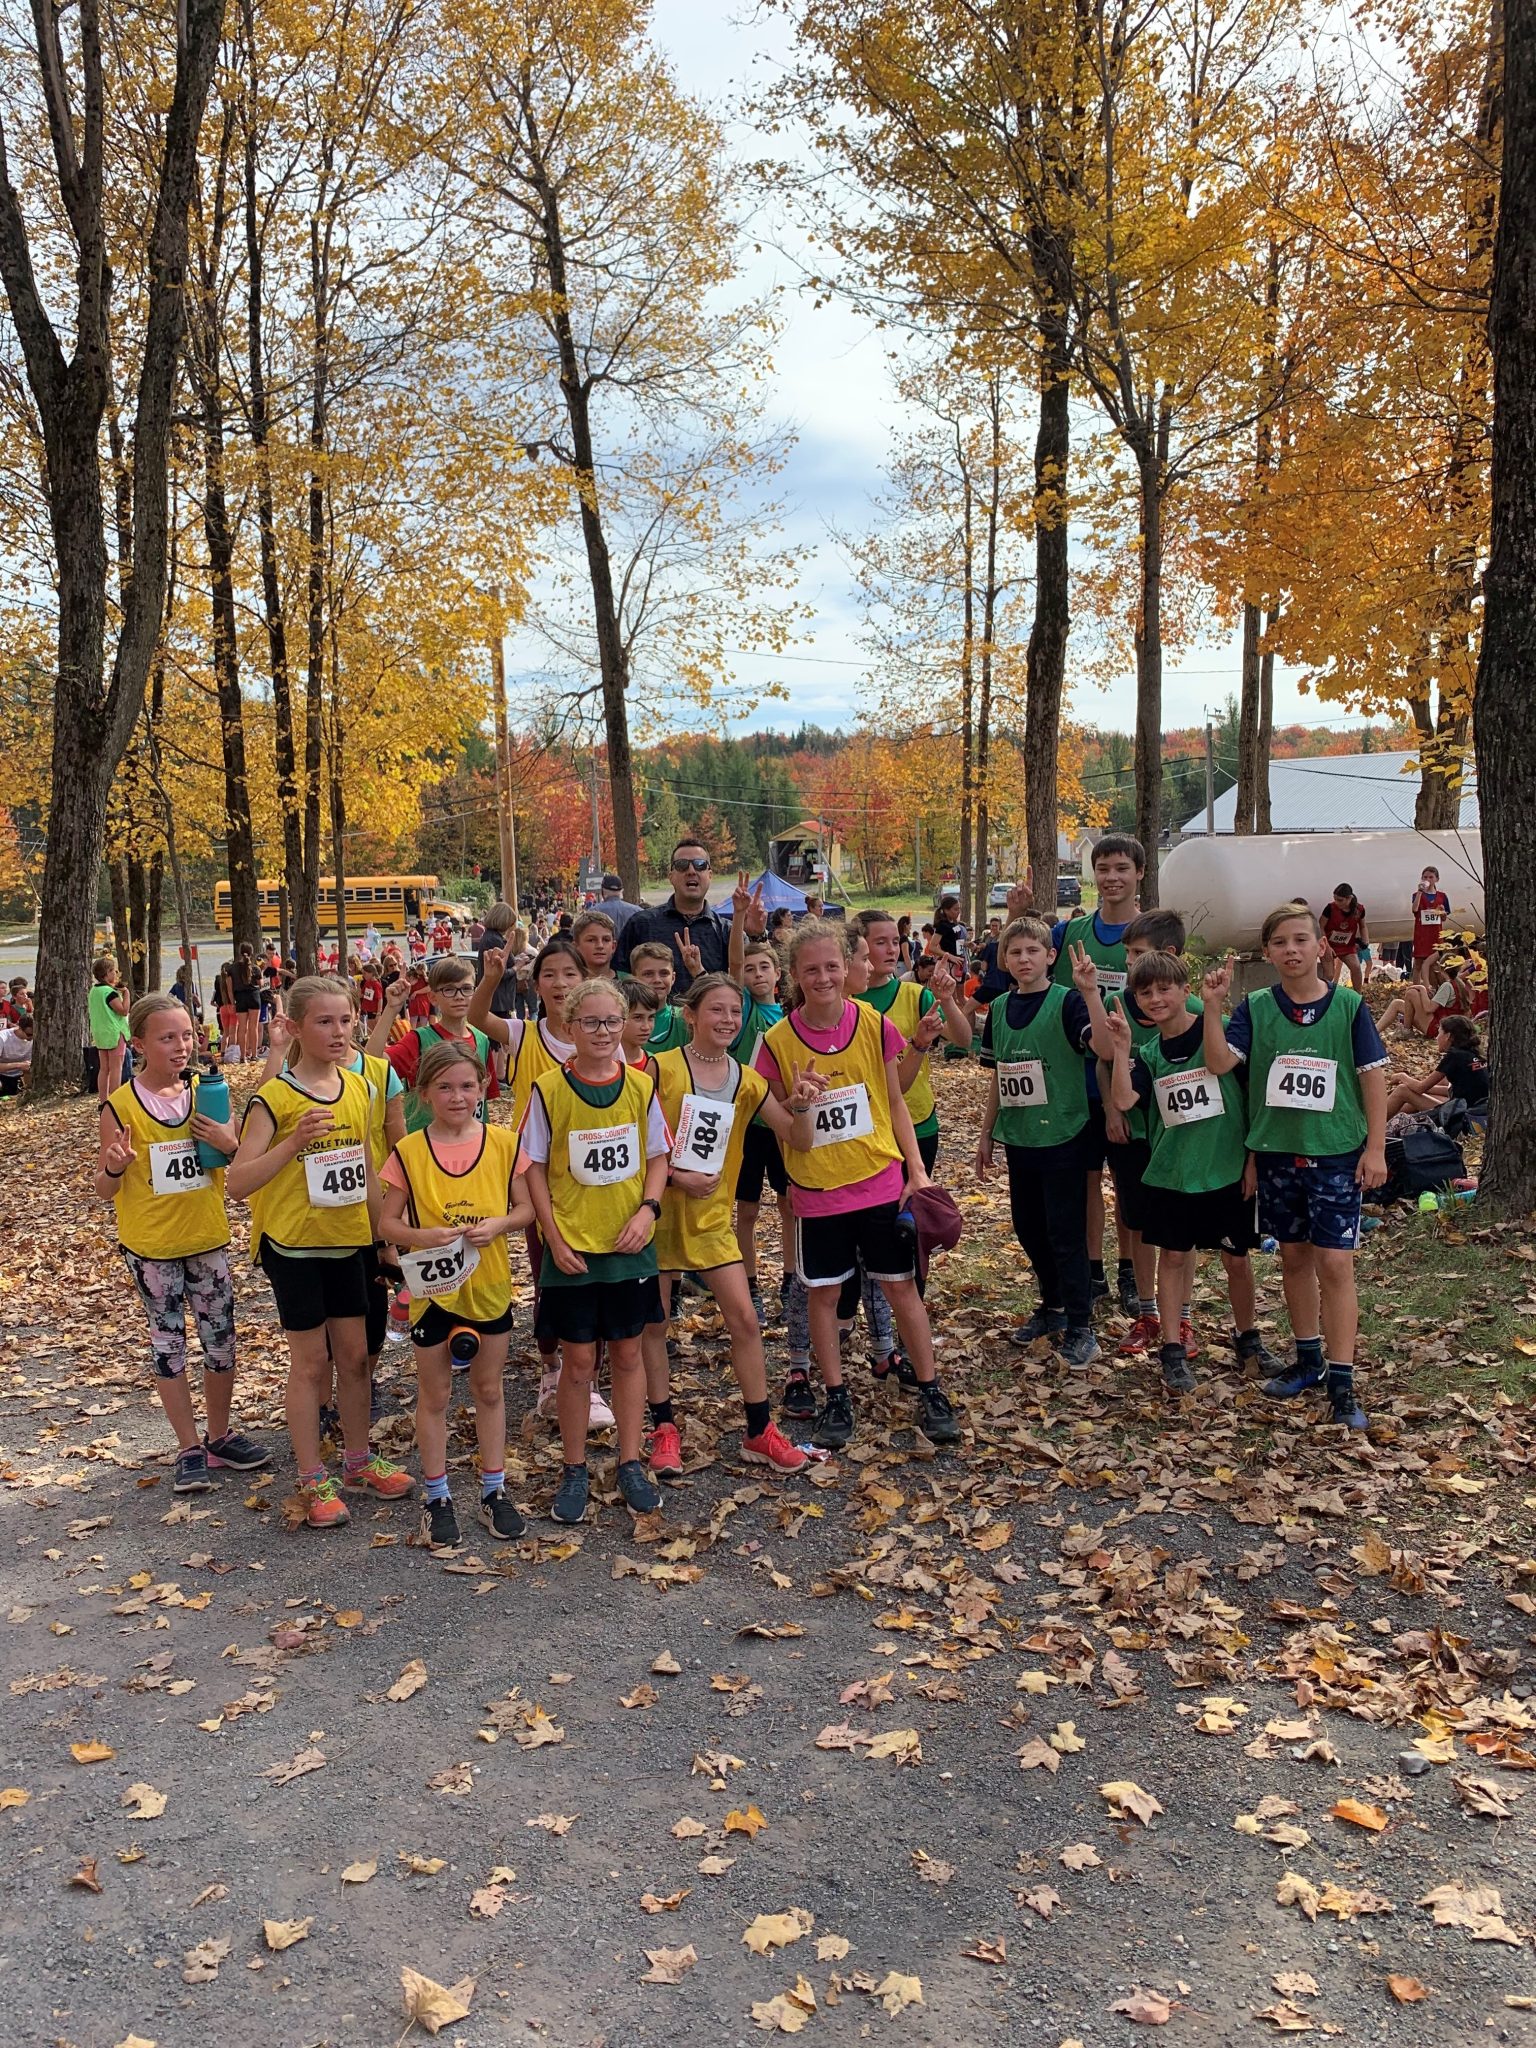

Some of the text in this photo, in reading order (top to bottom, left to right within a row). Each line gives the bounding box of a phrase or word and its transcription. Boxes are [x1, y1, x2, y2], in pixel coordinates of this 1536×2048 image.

[1278, 1058, 1331, 1069] CROSS-COUNTRY
[1000, 1076, 1034, 1097] 500
[1159, 1070, 1206, 1087] CROSS-COUNTRY
[1279, 1072, 1326, 1099] 496
[1168, 1085, 1210, 1113] 494
[675, 1102, 692, 1158] CROSS-COUNTRY
[816, 1103, 857, 1132] 487
[578, 1127, 630, 1141] CROSS-COUNTRY
[691, 1111, 721, 1160] 484
[584, 1143, 629, 1173] 483
[322, 1164, 366, 1194] 489
[416, 1248, 464, 1282] 482
